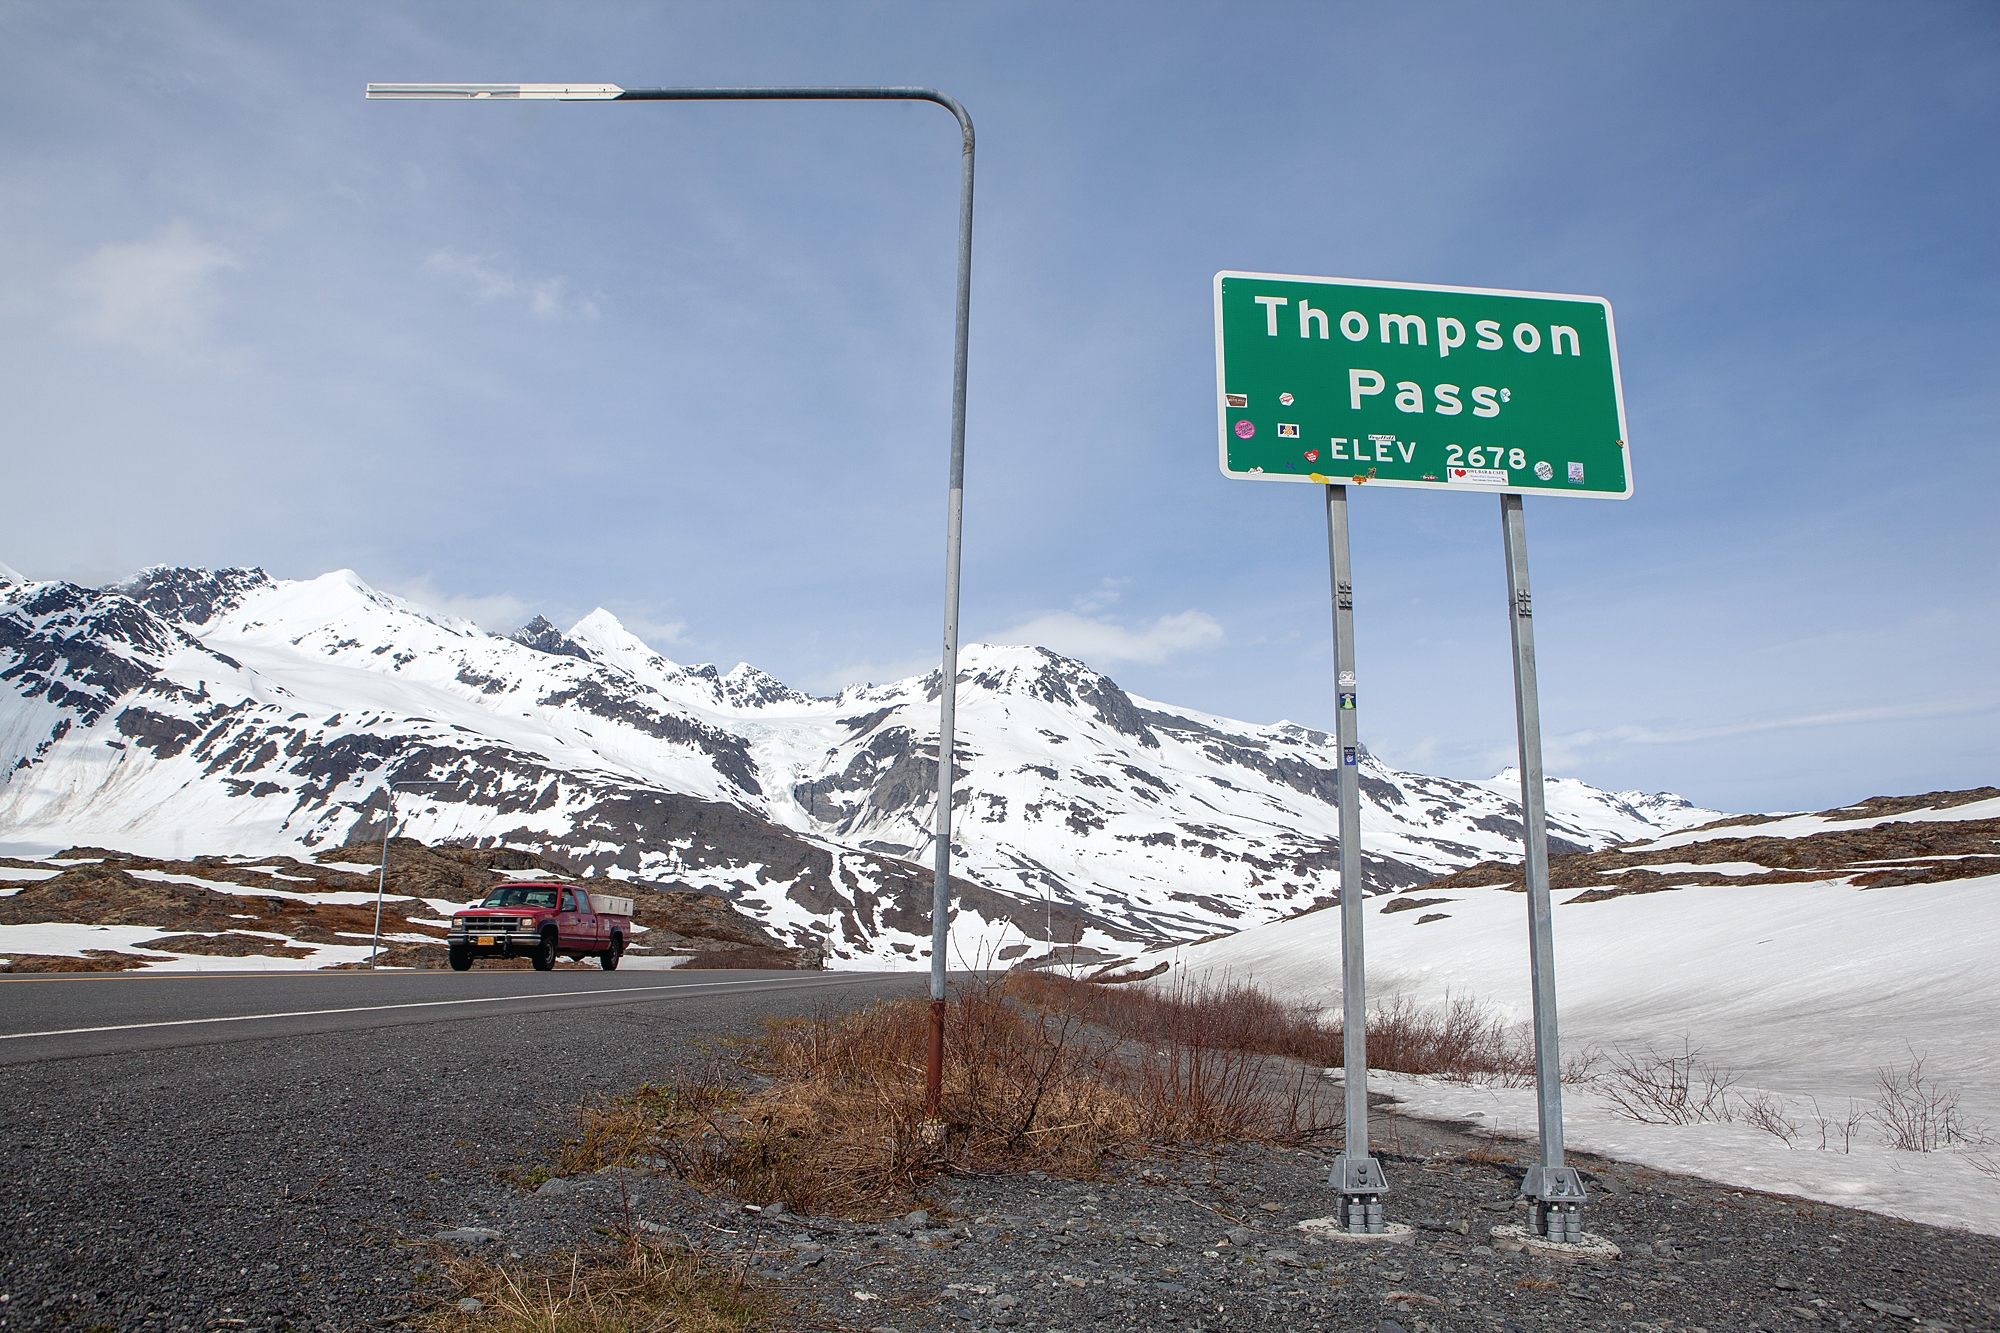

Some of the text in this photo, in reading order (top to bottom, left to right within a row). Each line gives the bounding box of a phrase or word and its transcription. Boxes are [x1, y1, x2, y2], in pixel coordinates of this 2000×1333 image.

[1255, 296, 1580, 356] Thompson
[1348, 368, 1501, 418] Pass
[1331, 438, 1526, 468] ELEV 2678
